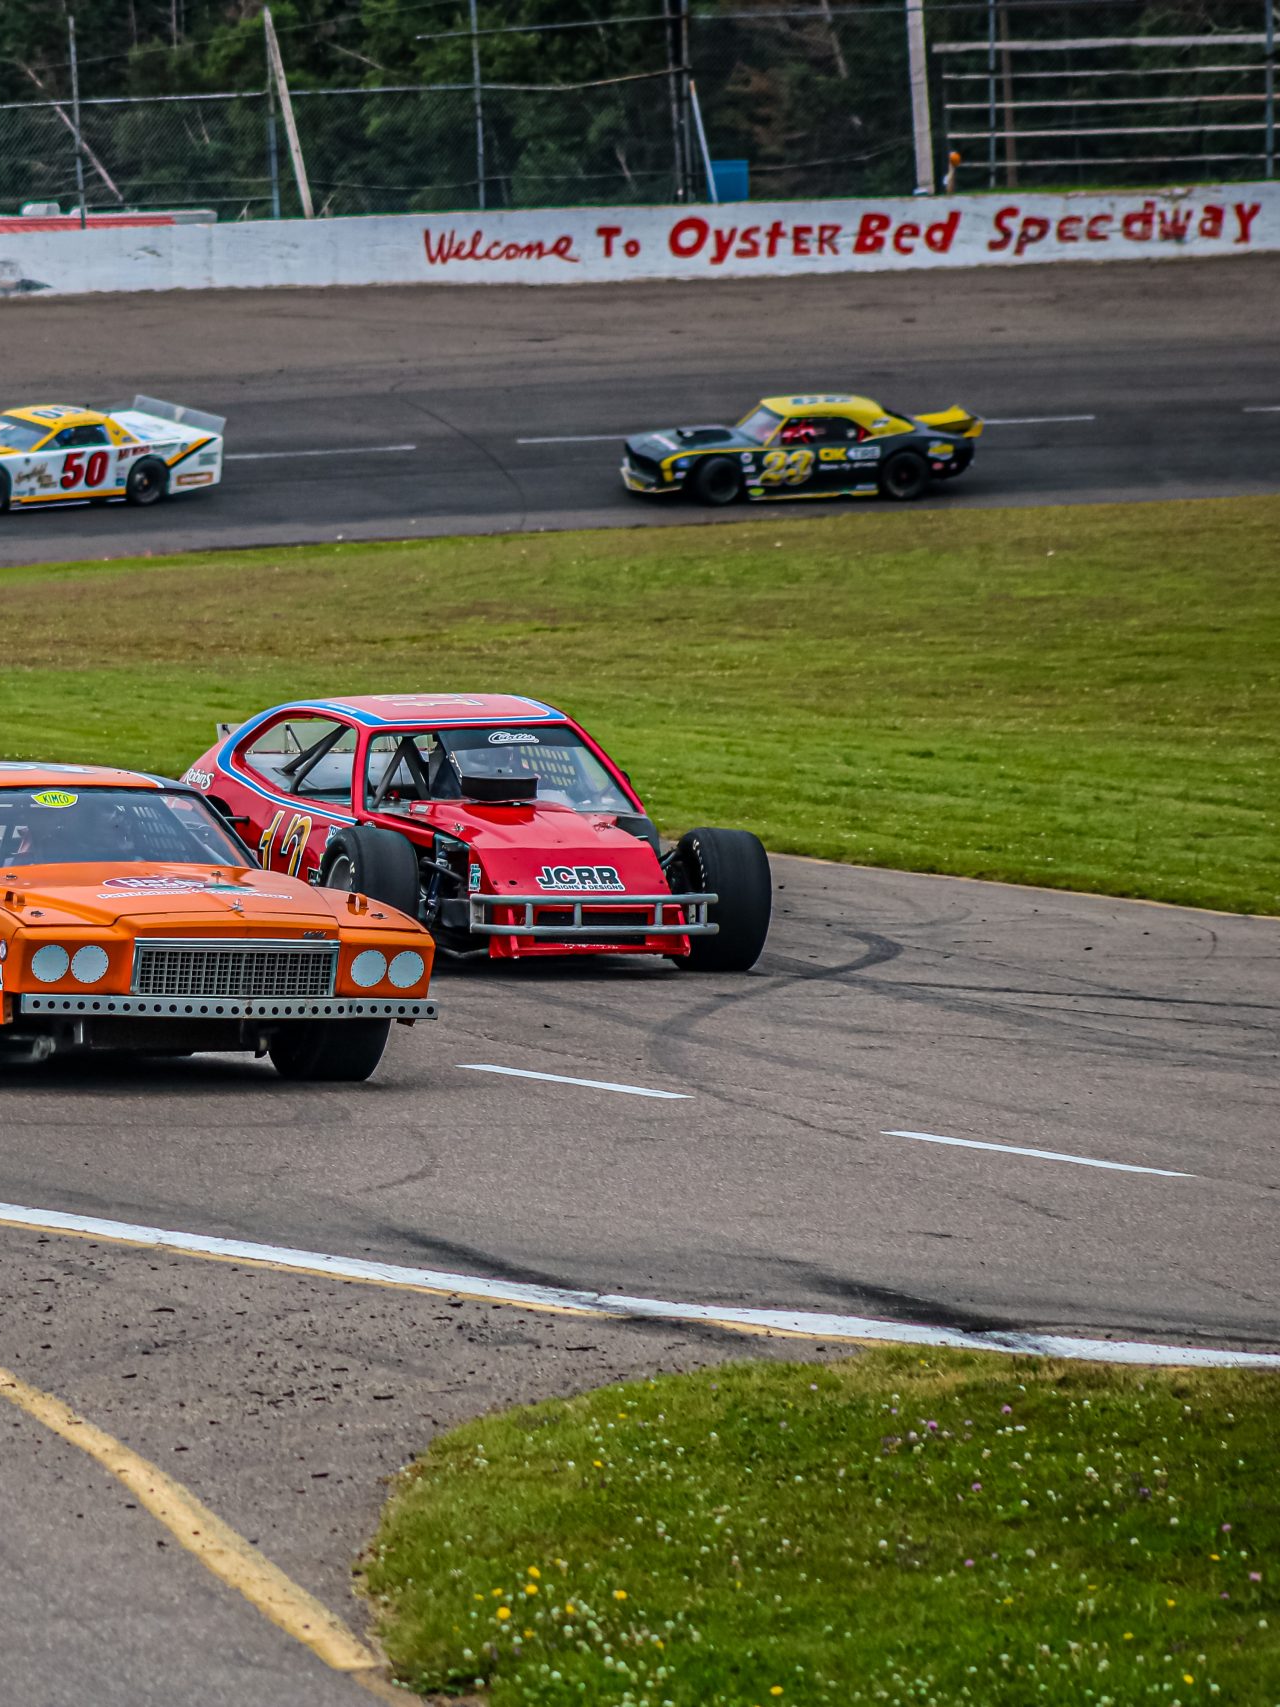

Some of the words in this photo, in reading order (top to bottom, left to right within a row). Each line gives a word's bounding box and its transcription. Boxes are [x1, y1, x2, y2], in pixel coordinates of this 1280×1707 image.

[424, 229, 580, 265] Welcome
[596, 226, 641, 258] To
[852, 211, 962, 255] Bed
[60, 450, 110, 490] 50
[762, 449, 815, 486] 23
[42, 794, 69, 804] KIMCO
[537, 867, 618, 885] JCRR
